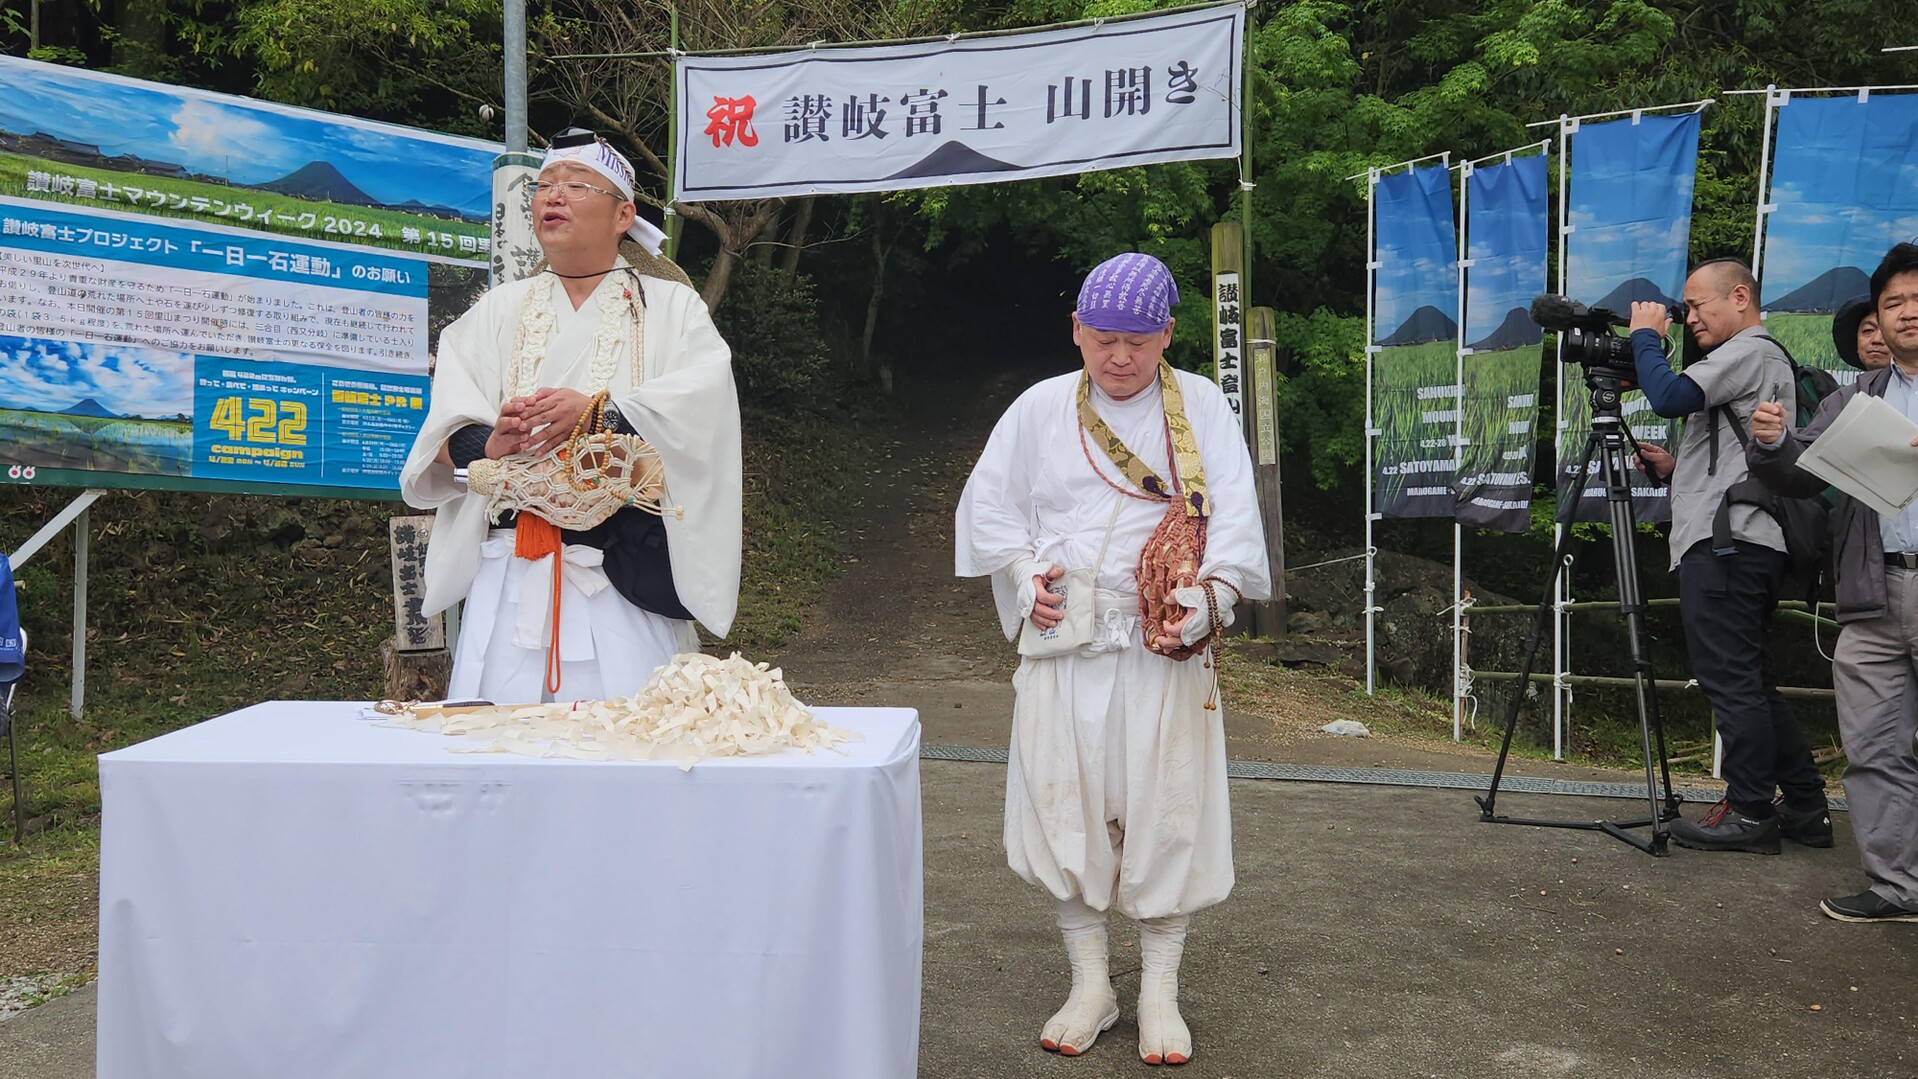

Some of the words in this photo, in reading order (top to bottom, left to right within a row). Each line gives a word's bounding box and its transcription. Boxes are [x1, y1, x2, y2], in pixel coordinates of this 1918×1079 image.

[704, 95, 760, 149] 祝
[783, 84, 1008, 145] 讃岐富士
[1047, 60, 1199, 124] 山開き
[595, 143, 634, 188] MISSIO
[324, 217, 383, 239] 2024
[1218, 283, 1241, 429] 讃岐富士登山
[210, 396, 307, 446] 422
[1631, 425, 1668, 440] WEEK
[211, 444, 304, 460] campaign
